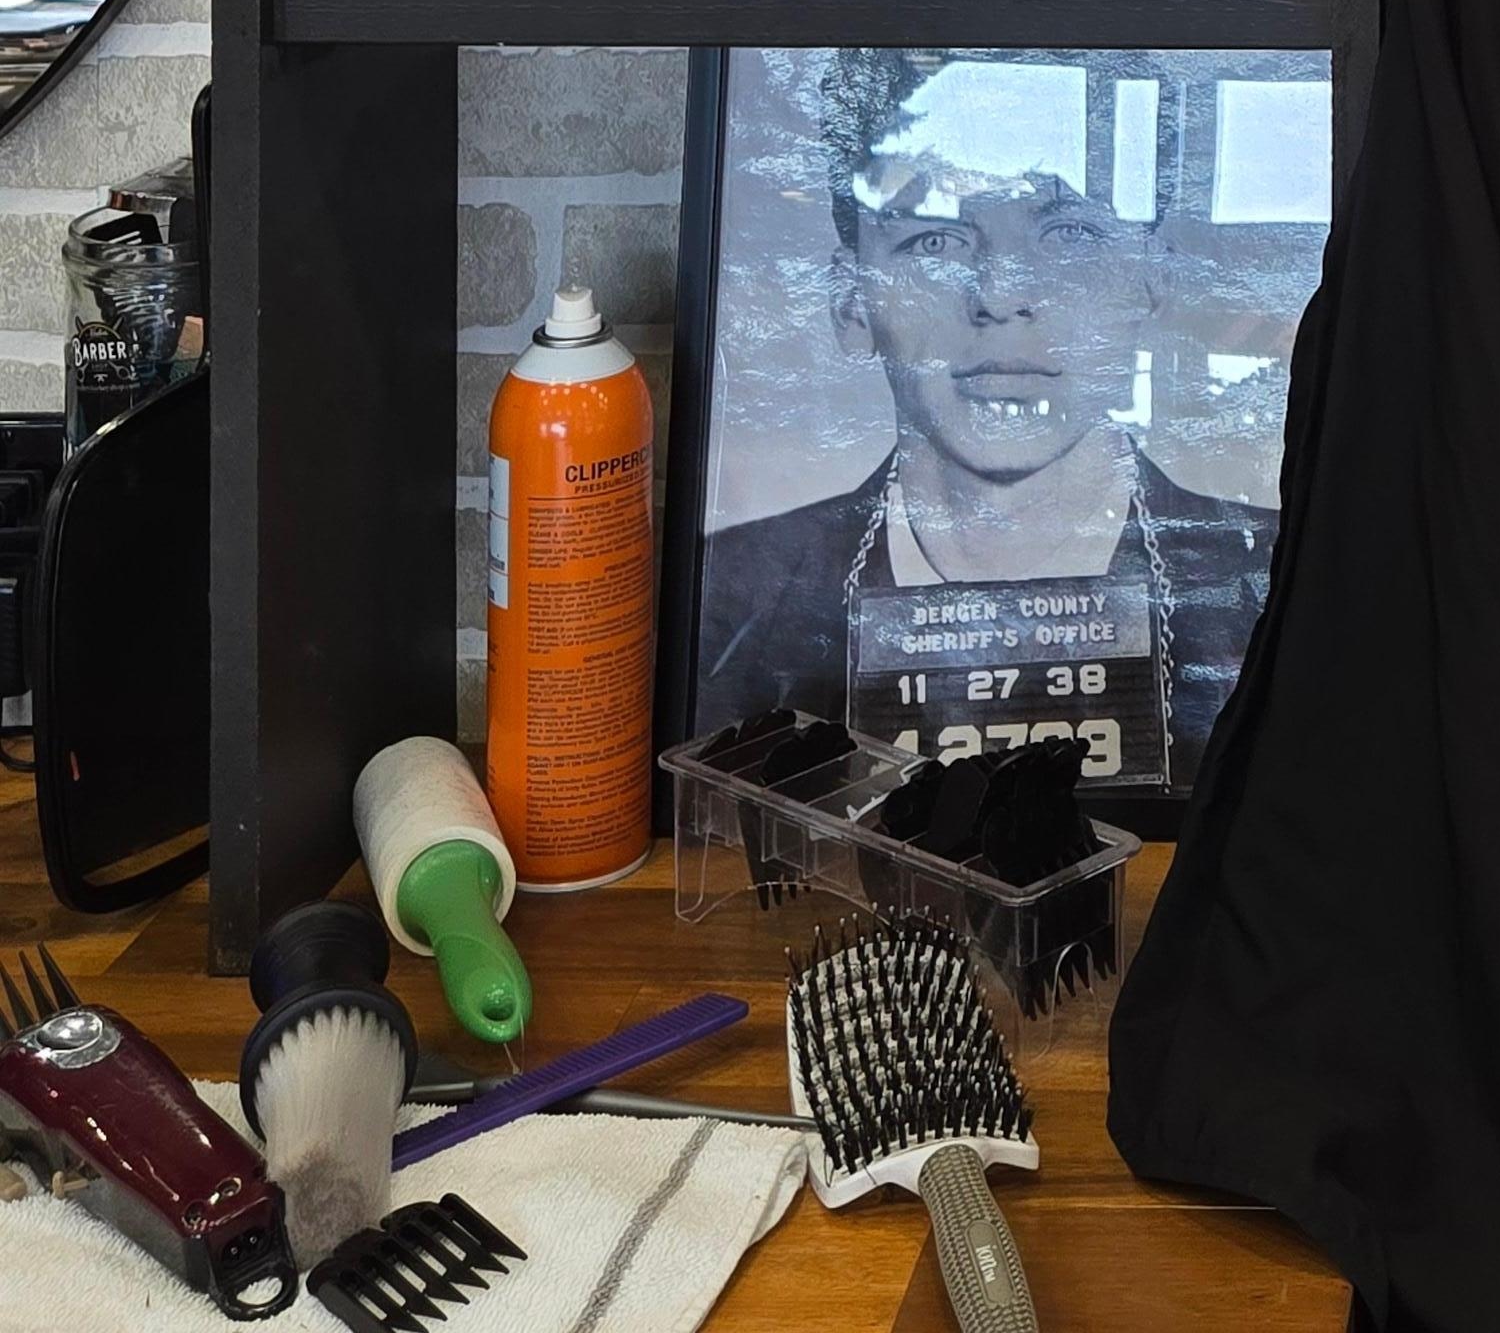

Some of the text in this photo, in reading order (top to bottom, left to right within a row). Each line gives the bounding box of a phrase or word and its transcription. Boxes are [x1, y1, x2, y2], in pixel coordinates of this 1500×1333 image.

[72, 337, 127, 367] BARBER
[565, 444, 650, 483] CLIPPERC
[912, 595, 1107, 626] BERGEN COUNTY
[900, 623, 1115, 655] SHERIFF'S OFFICE
[898, 664, 1107, 704] 11 27 38
